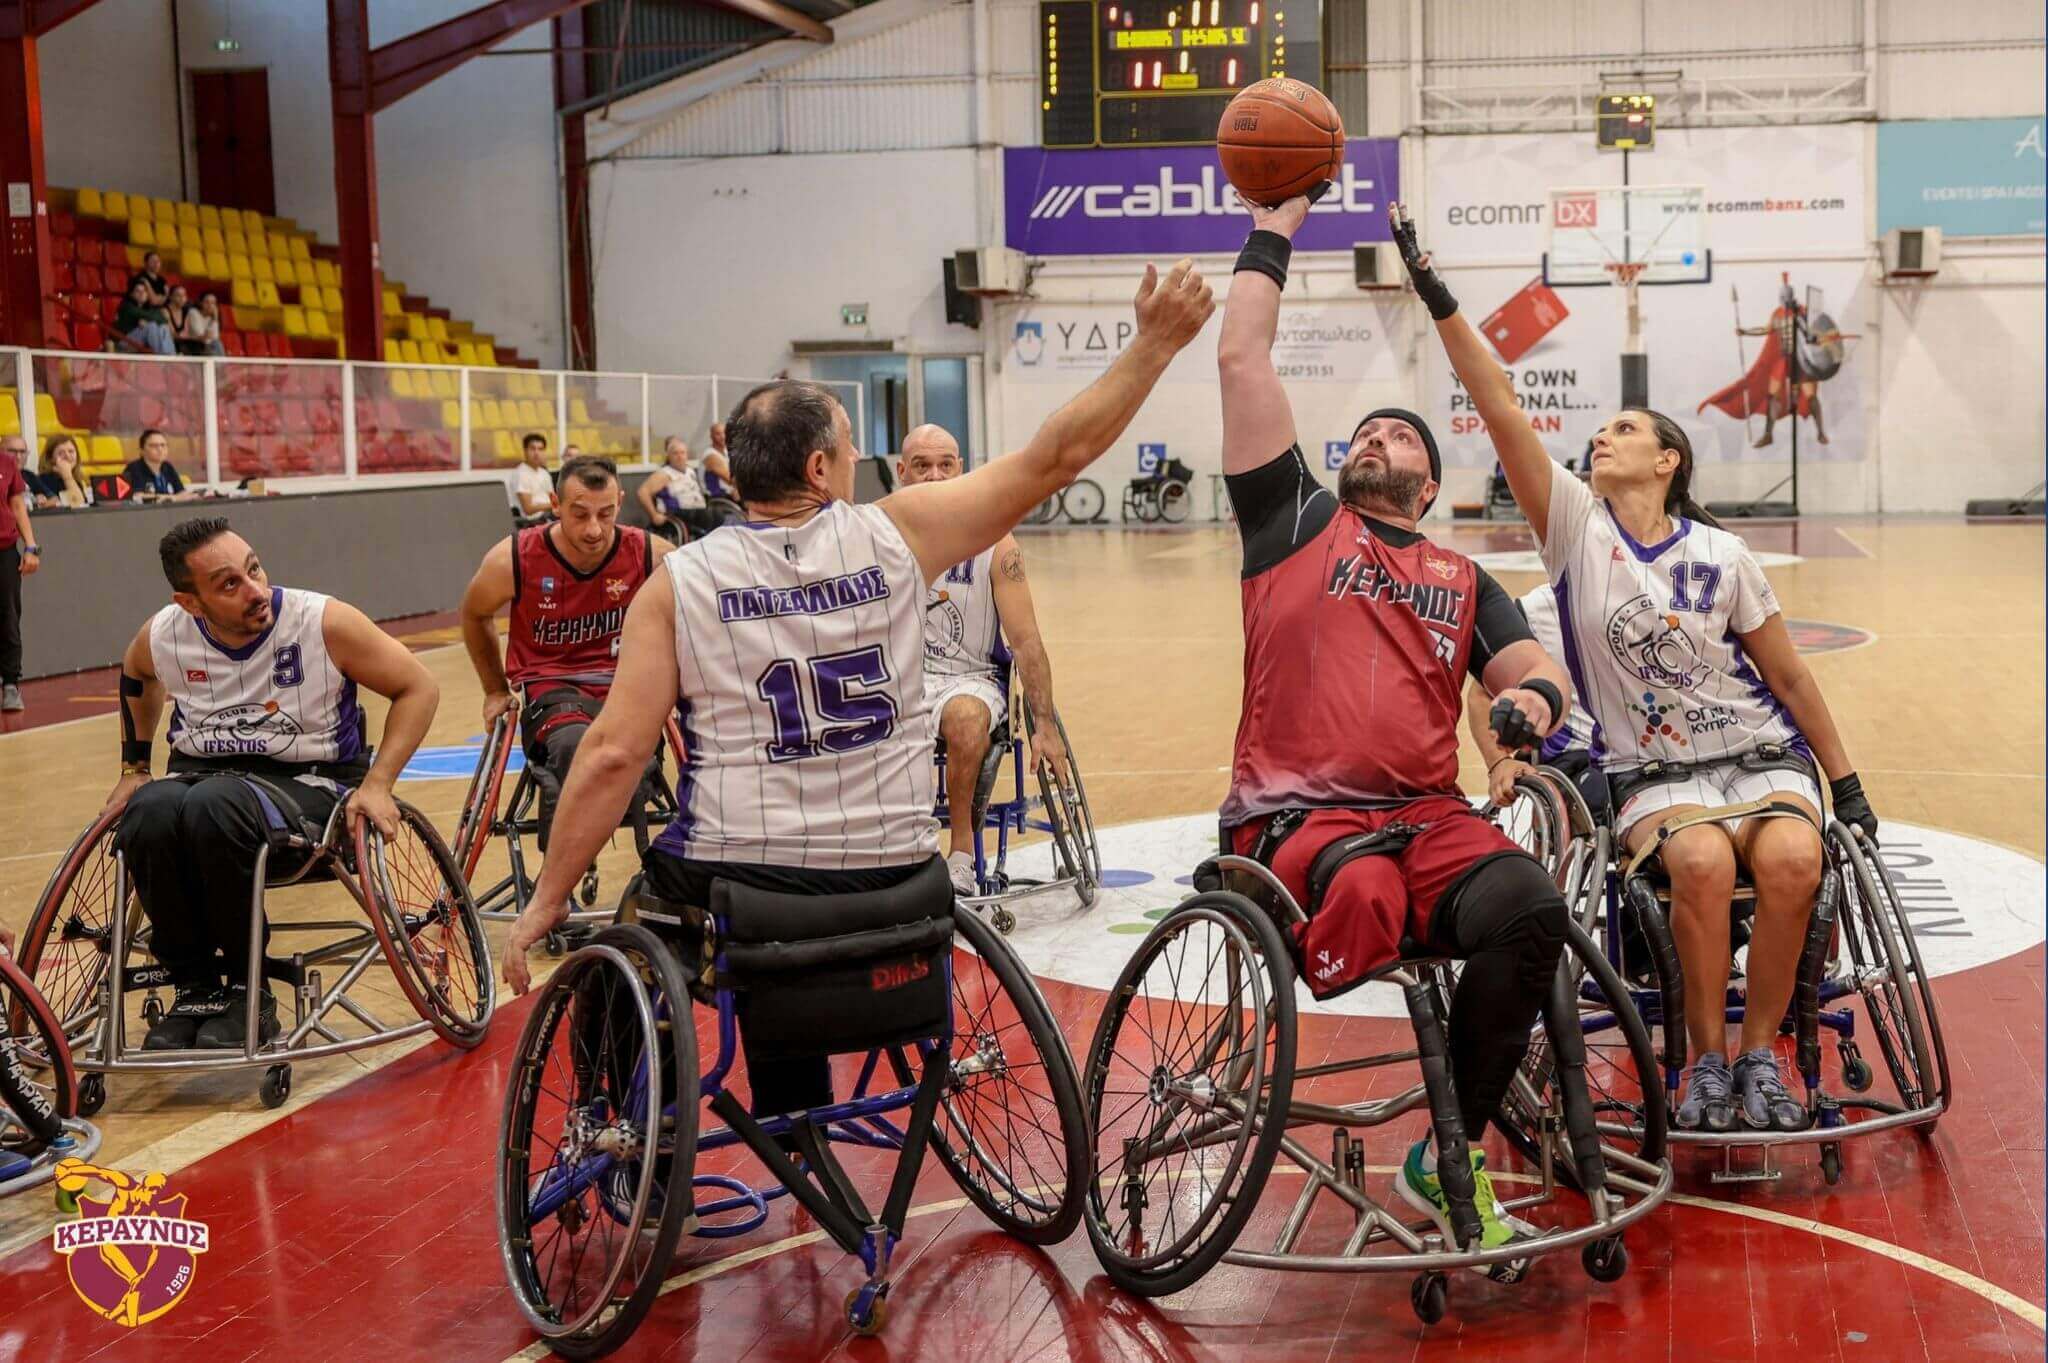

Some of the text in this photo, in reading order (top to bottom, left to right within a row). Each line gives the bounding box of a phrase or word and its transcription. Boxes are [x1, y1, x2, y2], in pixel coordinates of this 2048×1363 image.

[1083, 164, 1375, 218] cableet
[1524, 370, 1577, 387] OWN
[1669, 561, 1722, 613] 17
[272, 641, 305, 689] 9
[218, 707, 249, 721] CLUB
[756, 643, 899, 764] 15
